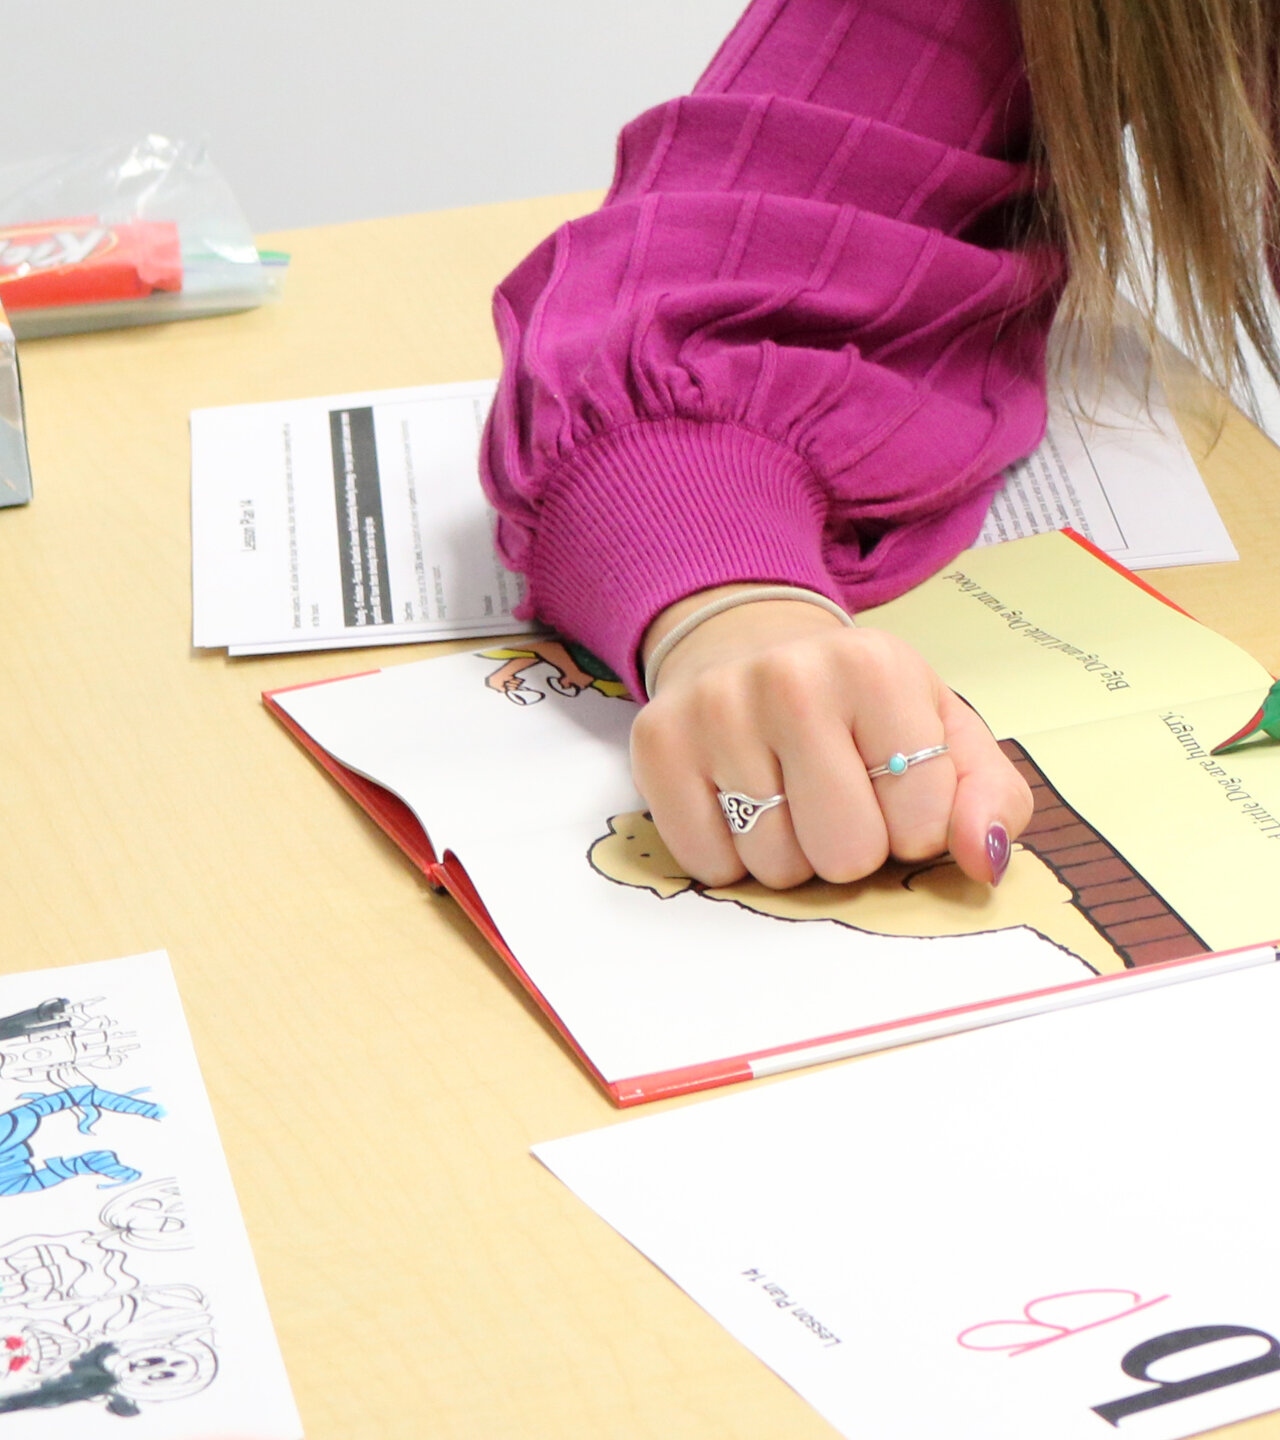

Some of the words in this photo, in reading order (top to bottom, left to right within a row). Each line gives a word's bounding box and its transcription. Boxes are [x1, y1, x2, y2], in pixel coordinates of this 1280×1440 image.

[971, 591, 1008, 613] want
[1000, 609, 1032, 630] Dog
[1023, 627, 1062, 649] Little
[1048, 642, 1084, 656] and
[1075, 653, 1108, 673] Dog
[1100, 669, 1131, 692] Big
[1160, 711, 1210, 761] hungry.
[1199, 759, 1227, 777] are
[1217, 776, 1251, 802] Dog
[740, 1267, 767, 1283] 14
[761, 1282, 798, 1309] Plan
[790, 1307, 842, 1348] Lesson
